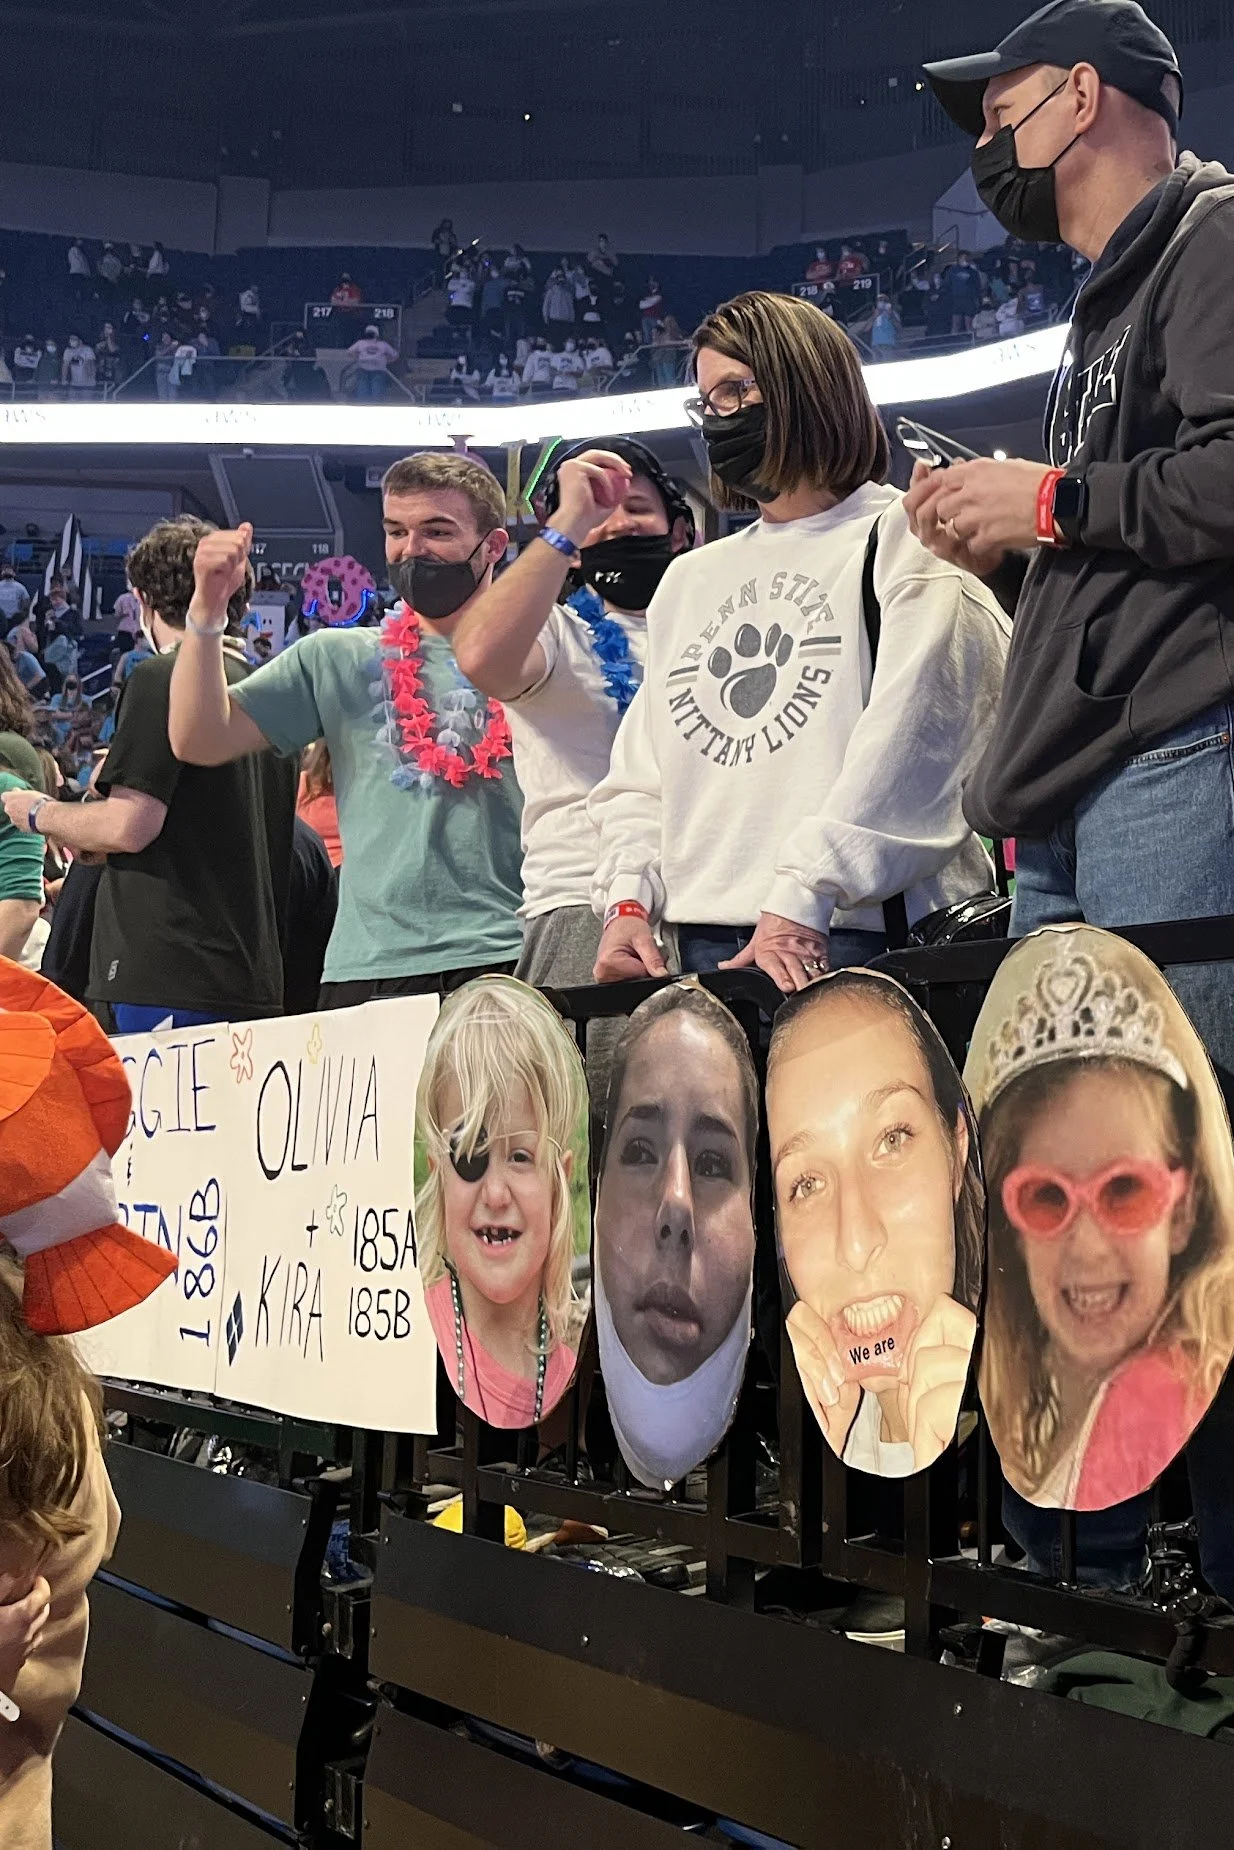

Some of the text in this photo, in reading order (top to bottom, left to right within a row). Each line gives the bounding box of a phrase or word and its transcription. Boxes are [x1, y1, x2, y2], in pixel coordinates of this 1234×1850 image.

[312, 306, 395, 319] 217 218
[799, 278, 872, 297] 218 219
[680, 577, 758, 662] PENN
[668, 665, 833, 767] NITTANY LIONS
[256, 1054, 379, 1181] OLIVIA
[179, 1177, 222, 1348] 186B
[353, 1206, 417, 1272] 185A
[254, 1254, 325, 1363] KIRA
[348, 1287, 411, 1341] 185B
[848, 1337, 895, 1365] We are
